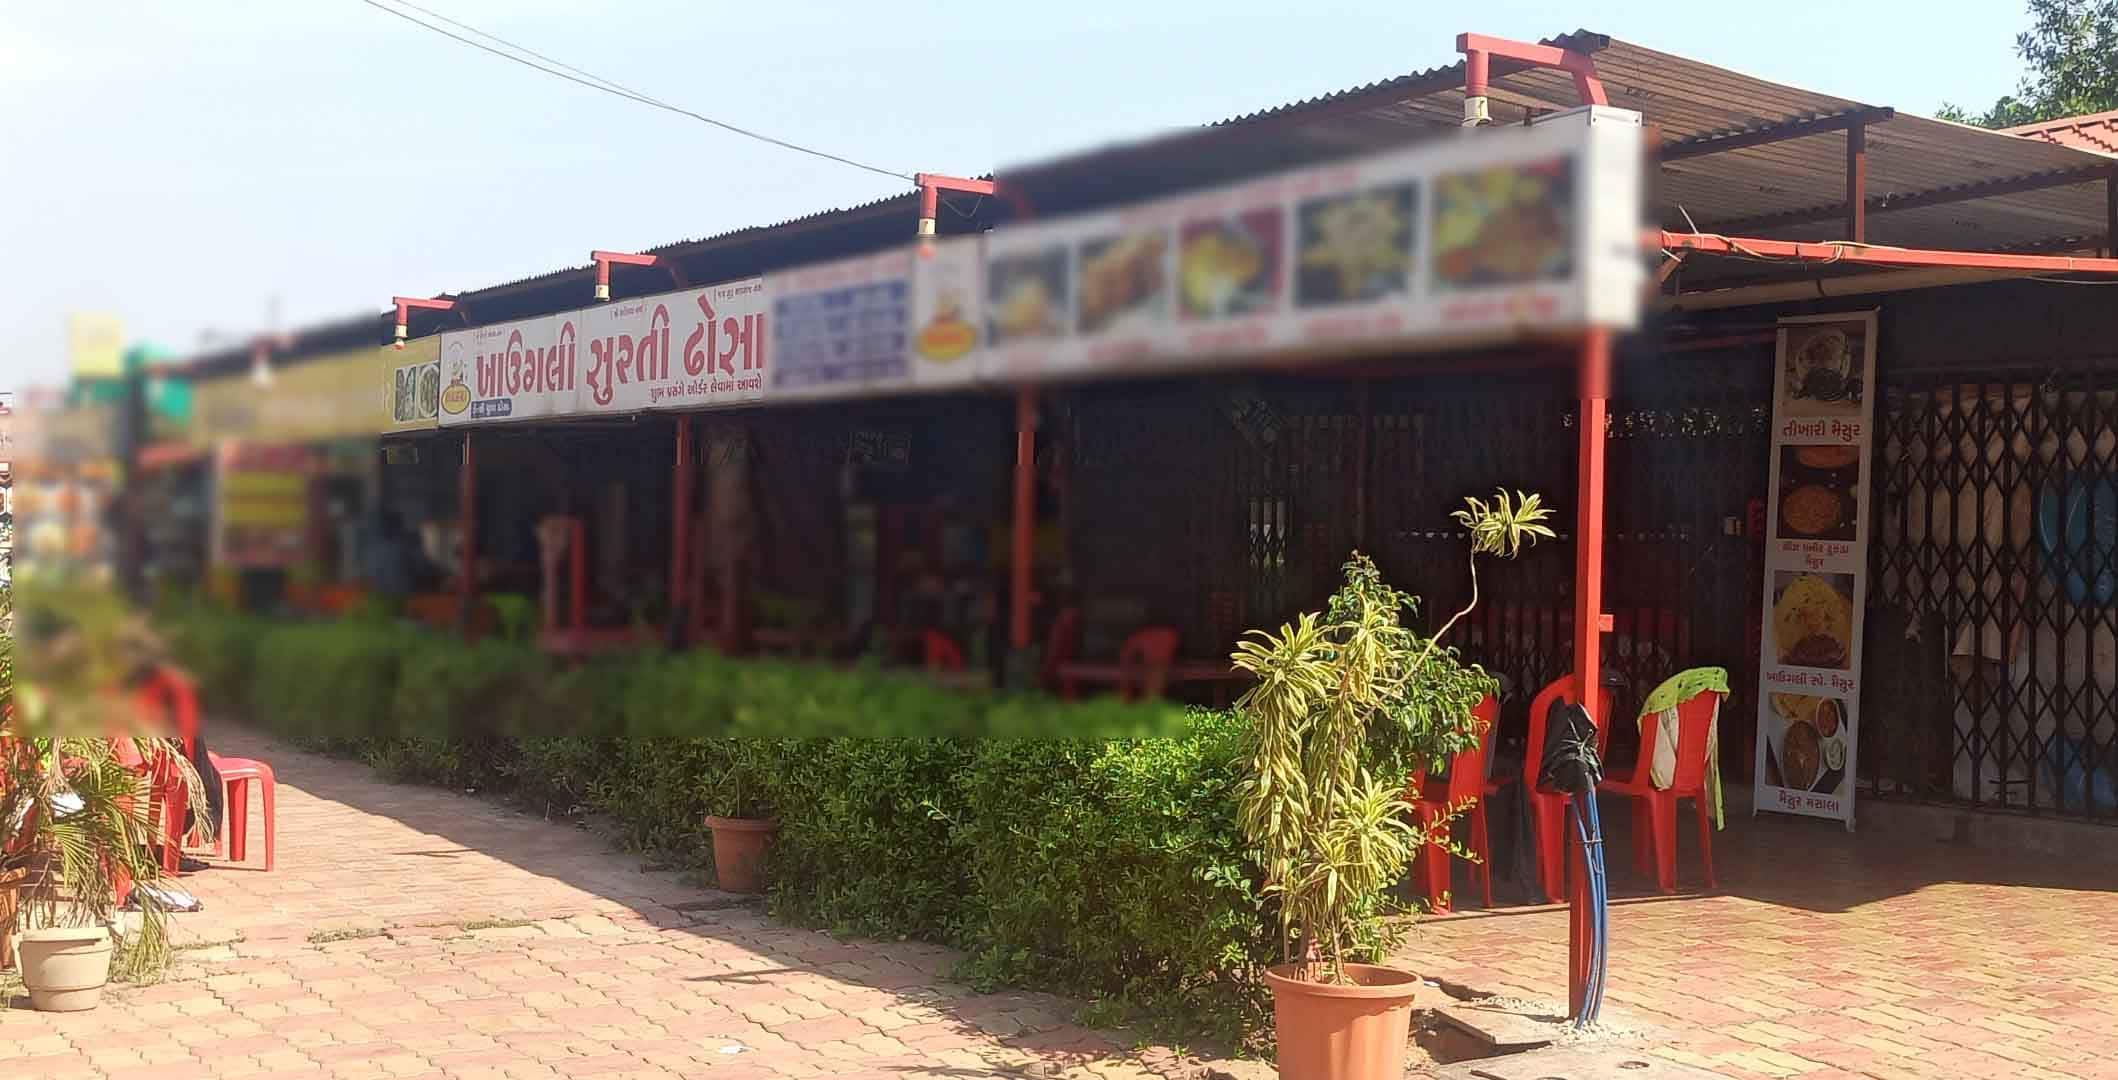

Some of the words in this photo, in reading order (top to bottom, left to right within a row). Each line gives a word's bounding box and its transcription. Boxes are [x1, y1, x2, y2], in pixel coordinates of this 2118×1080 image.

[475, 320, 576, 398] ખાઉગલી
[586, 303, 670, 406] સુરતી
[683, 294, 764, 377] ઢોસા
[737, 373, 762, 391] આવશે
[1783, 419, 1825, 437] તીખારી
[1831, 418, 1861, 442] મૈસુર
[1806, 797, 1840, 813] મસાલા
